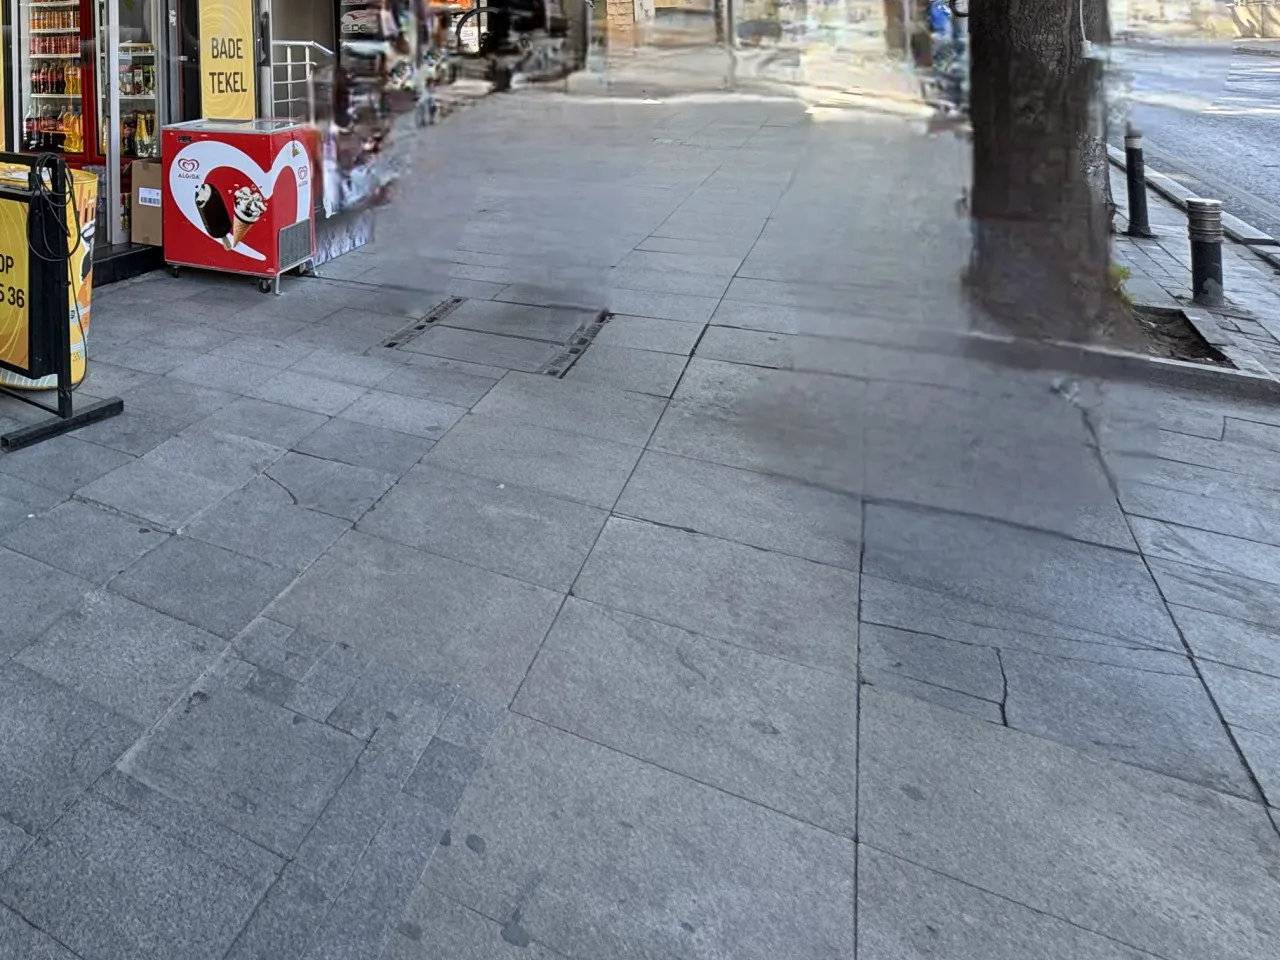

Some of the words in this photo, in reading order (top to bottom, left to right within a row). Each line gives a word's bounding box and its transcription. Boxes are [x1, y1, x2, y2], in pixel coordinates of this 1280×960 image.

[211, 36, 244, 61] BADE
[209, 70, 247, 95] TEKEL
[8, 286, 25, 308] 36
